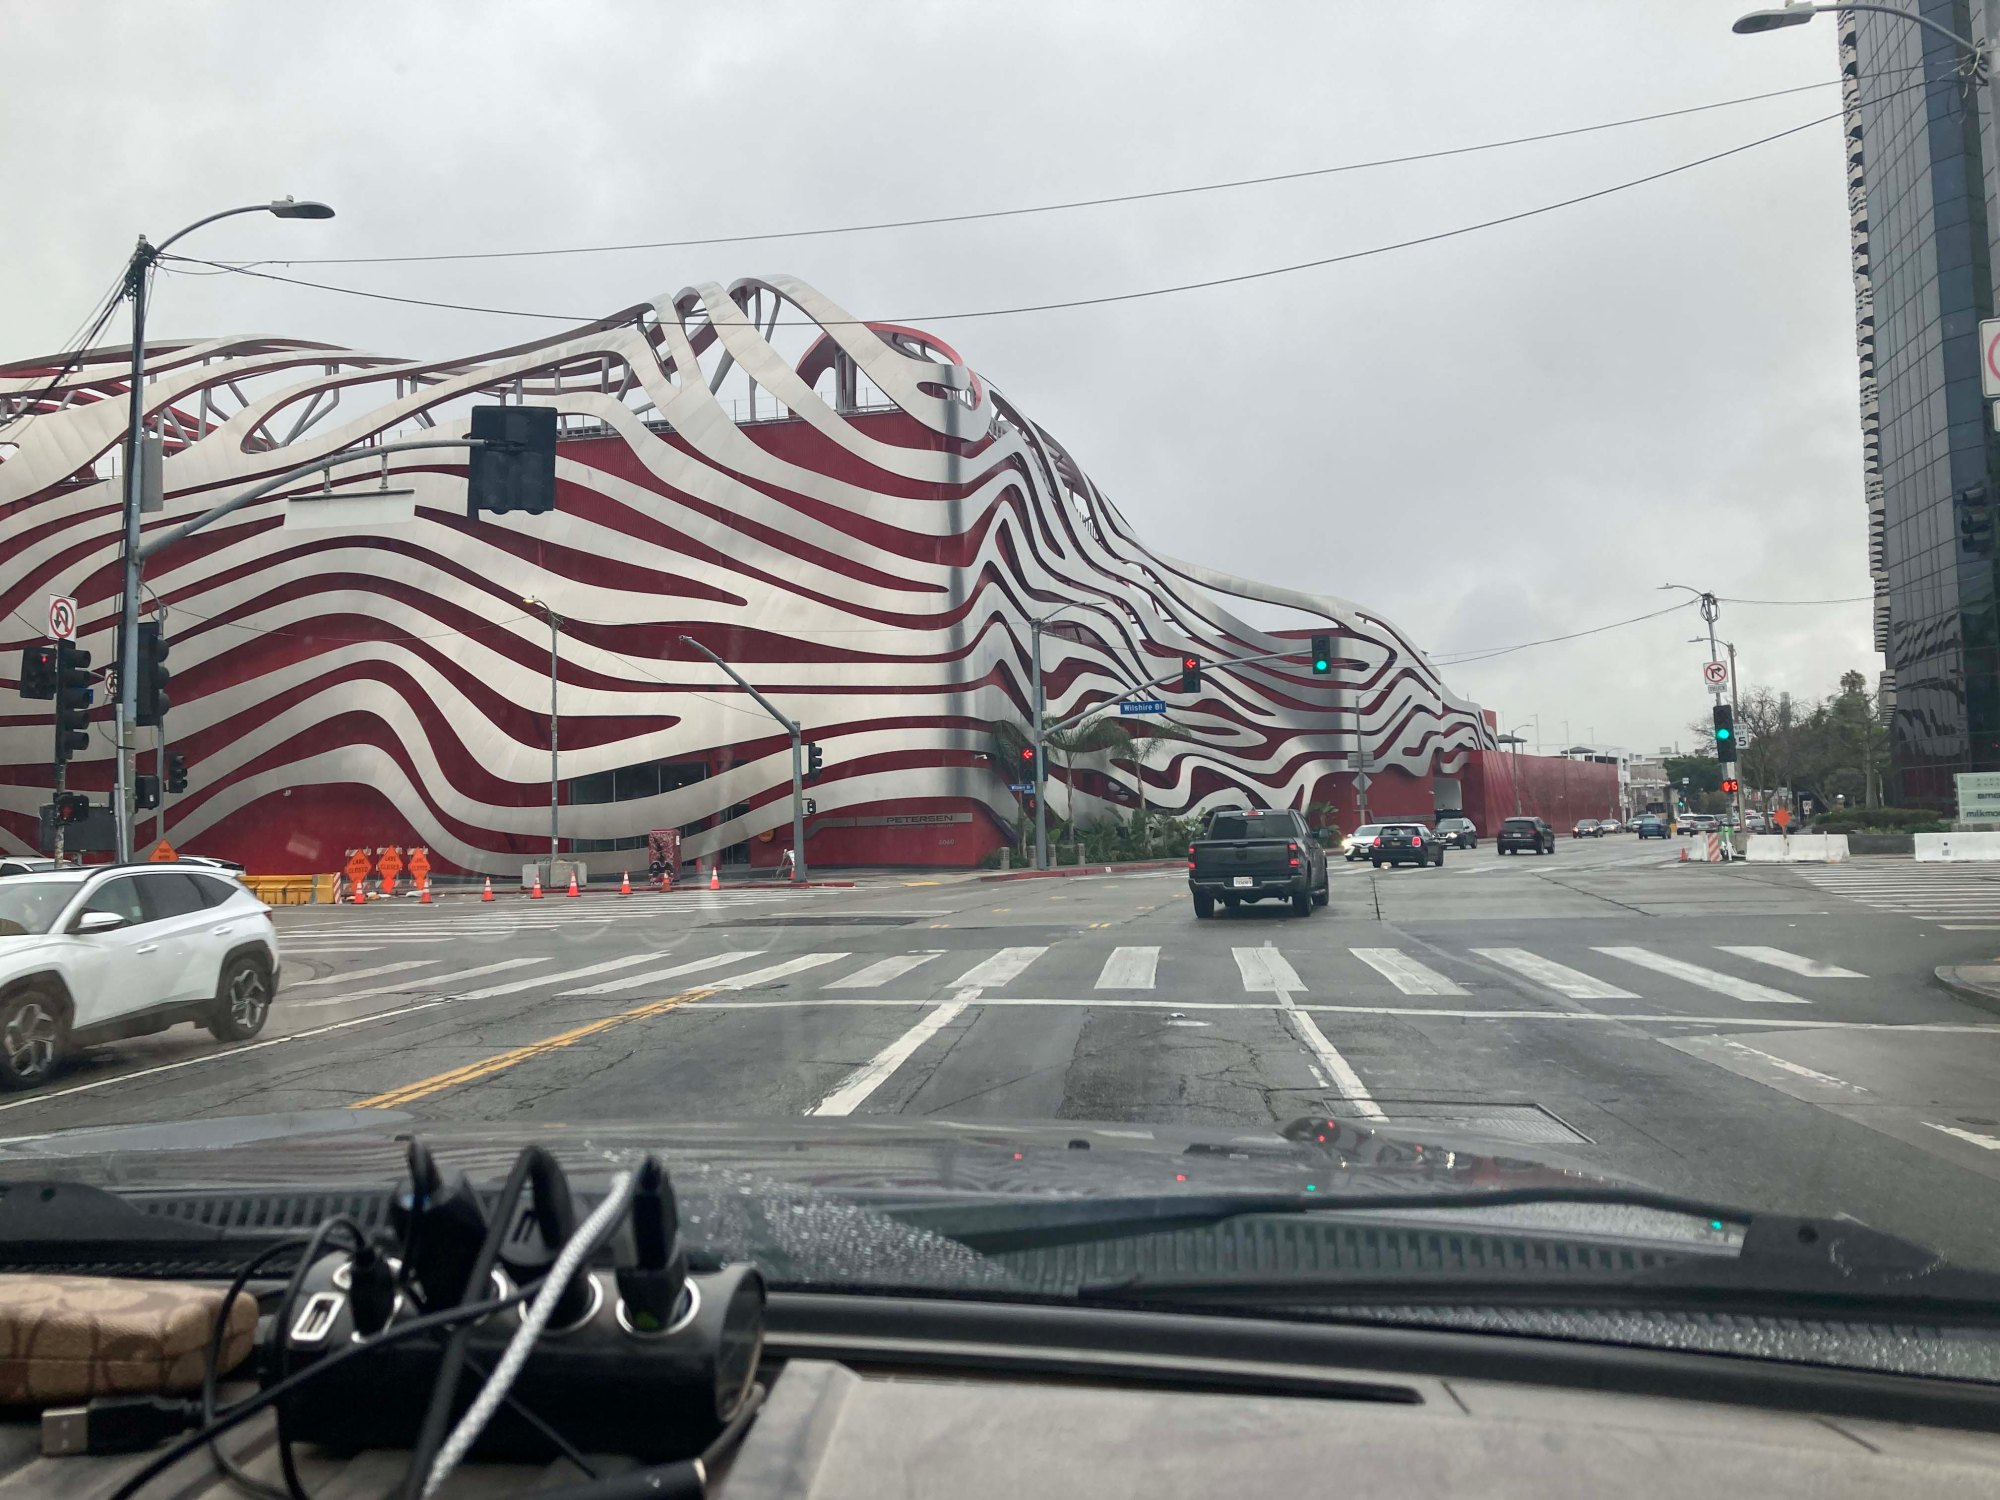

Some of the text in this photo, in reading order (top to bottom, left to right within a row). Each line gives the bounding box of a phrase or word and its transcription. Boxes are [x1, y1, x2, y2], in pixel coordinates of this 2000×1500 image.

[1738, 736, 1747, 747] 5
[1966, 809, 2000, 818] milkmo
[886, 815, 953, 823] PETERSEN
